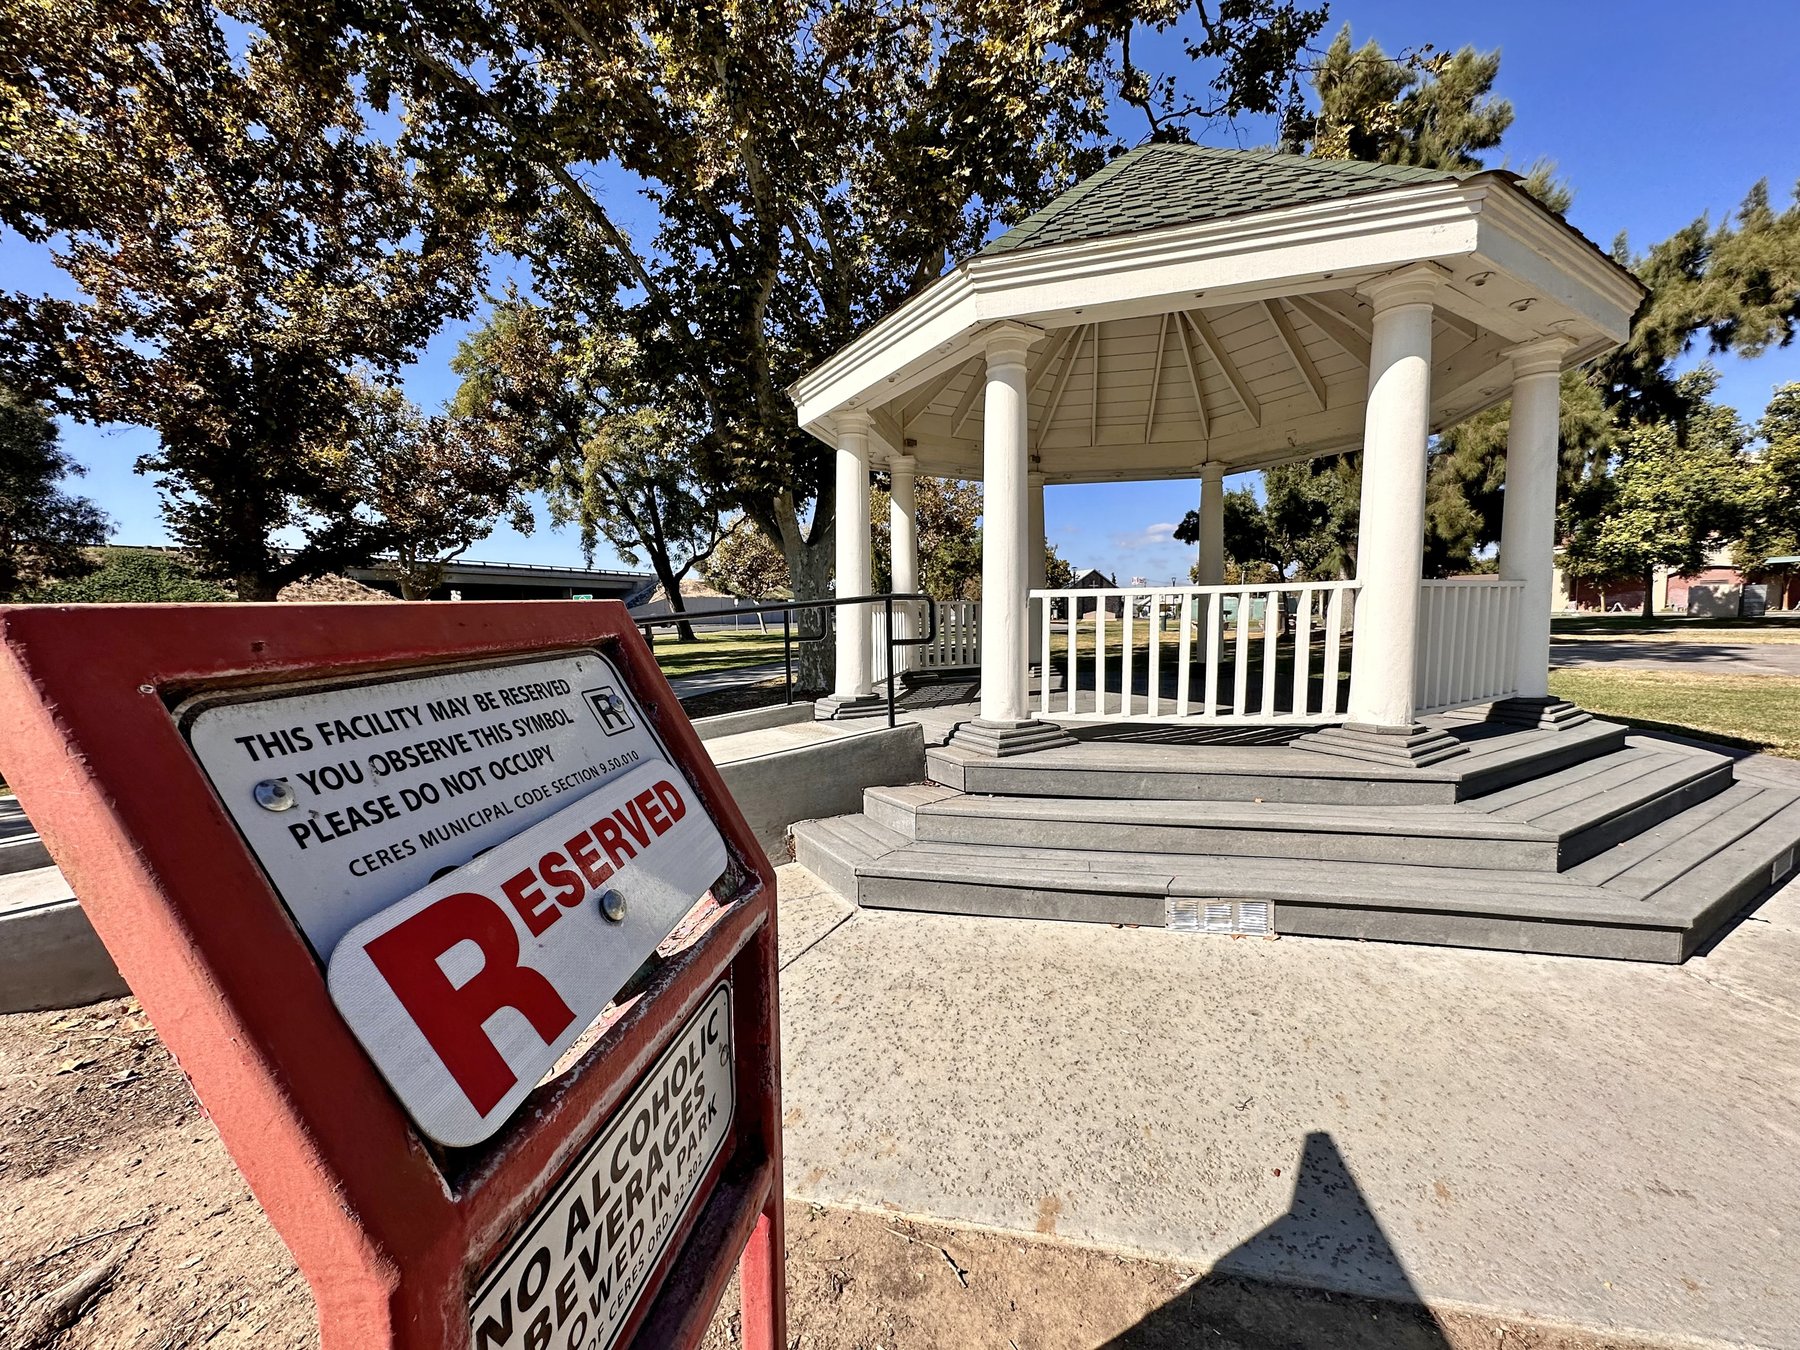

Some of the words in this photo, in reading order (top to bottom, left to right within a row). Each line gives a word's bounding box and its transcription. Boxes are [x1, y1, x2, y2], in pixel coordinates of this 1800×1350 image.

[234, 727, 313, 761] THIS
[315, 705, 423, 746] FACILITY
[427, 696, 472, 722] MAY
[473, 692, 500, 712] BE
[498, 679, 571, 707] RESERVED
[288, 795, 401, 850] PLEASE
[398, 781, 441, 813] DO
[440, 766, 486, 798] NOT
[488, 745, 555, 780] OCCUPY
[296, 760, 364, 795] YOU
[368, 734, 472, 776] OBSERVE
[468, 723, 513, 746] THIS
[512, 709, 575, 737] SYMBOL
[349, 839, 417, 877] CERES
[418, 801, 514, 849] MUNICIPAL
[514, 785, 552, 808] CODE
[551, 765, 600, 794] SECTION
[599, 750, 640, 774] 9.50.010
[363, 780, 687, 1119] RESERVED
[476, 1246, 551, 1350] NO
[564, 1009, 719, 1261] ALCOHOLIC
[523, 1070, 706, 1350] BEVERAGES
[567, 1218, 645, 1350] OWED
[651, 1171, 671, 1222] IN
[676, 1092, 717, 1179] PARK
[609, 1254, 645, 1321] CERES
[648, 1213, 672, 1252] ORD.
[673, 1152, 703, 1209] 92-802
